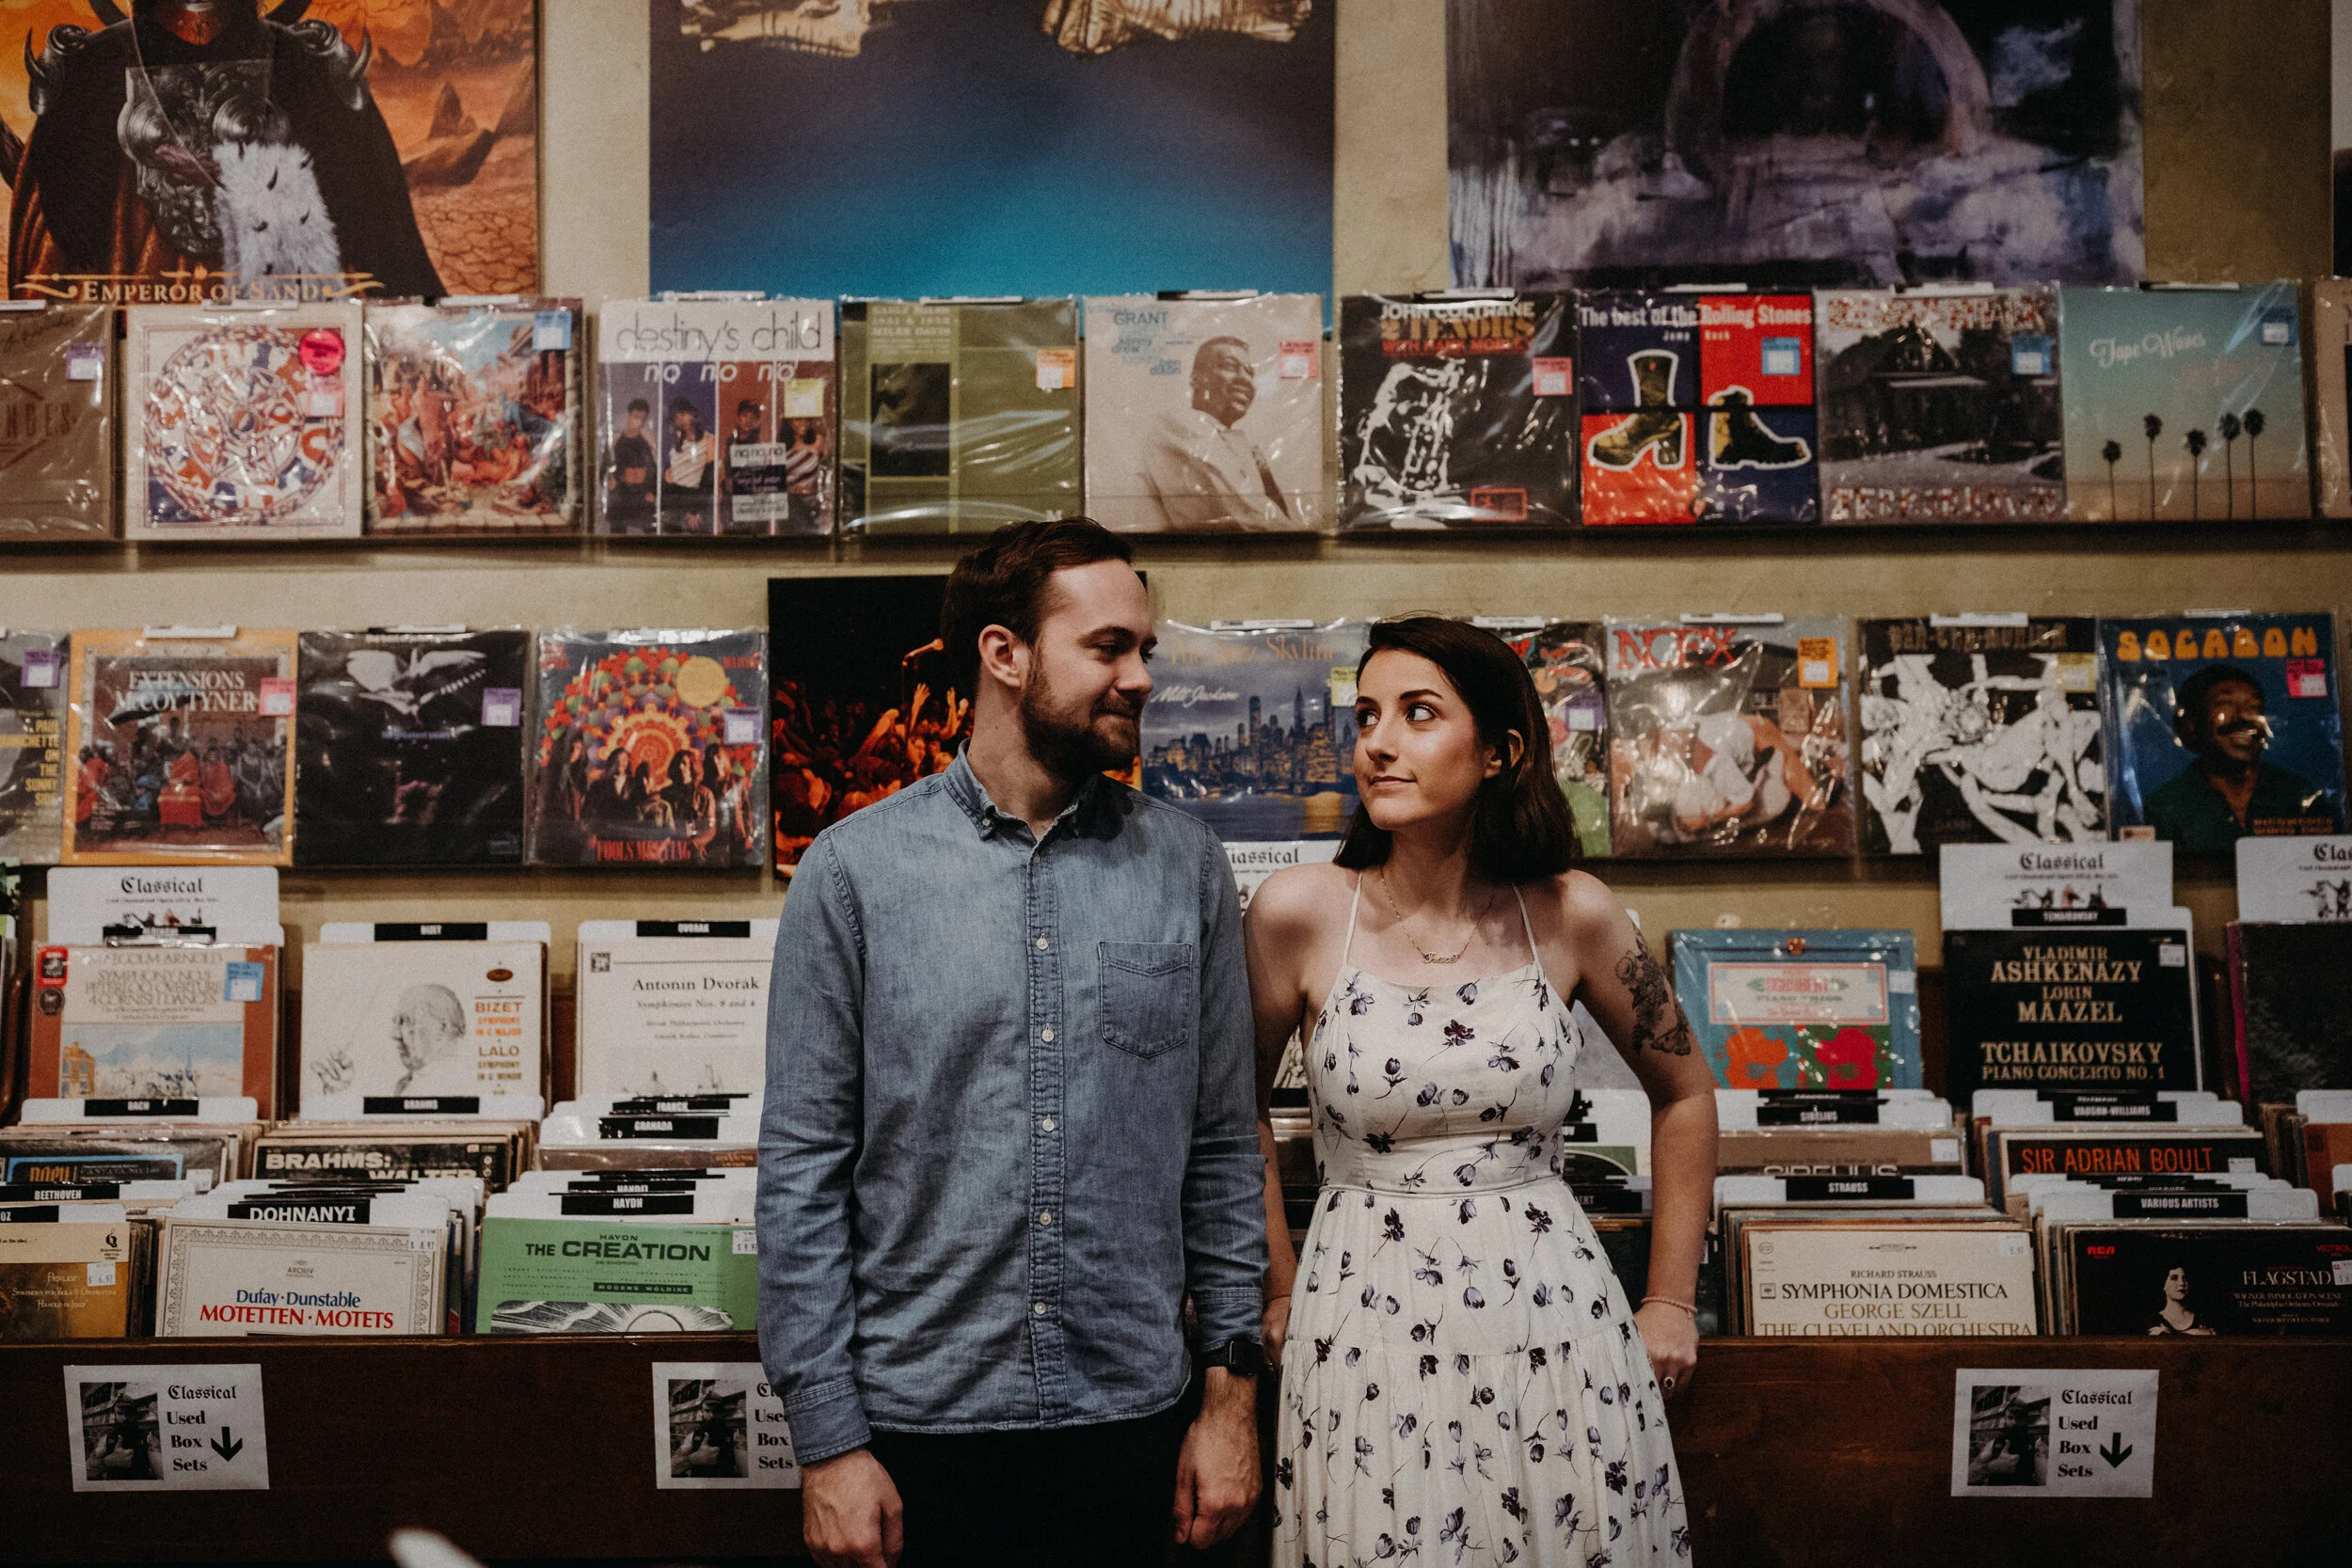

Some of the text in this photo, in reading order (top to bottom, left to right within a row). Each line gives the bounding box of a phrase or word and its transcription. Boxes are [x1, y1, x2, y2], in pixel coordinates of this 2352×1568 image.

[84, 280, 320, 303] EMPEROR OF SAND
[1113, 311, 1168, 326] GRANT
[1380, 301, 1535, 321] JOHN COLTRANE
[1580, 308, 1608, 326] The
[1611, 306, 1647, 326] best
[1651, 304, 1670, 327] of
[1672, 304, 1697, 327] the
[1701, 304, 1756, 329] Rolling
[1756, 304, 1812, 325] Stones
[1380, 315, 1535, 341] 2 TENORS
[616, 310, 822, 362] destiny's child
[645, 361, 797, 384] no no no
[1613, 626, 1738, 670] NOFX
[2116, 626, 2318, 661] SOCABON
[129, 671, 246, 692] EXTENSIONS
[189, 692, 256, 713] TYNER
[2020, 852, 2105, 871] Classical
[120, 875, 204, 895] Classical
[166, 951, 224, 966] ARNOLD
[2022, 946, 2108, 961] VLADIMIR
[1990, 960, 2143, 983] ASHKENAZY
[2042, 986, 2093, 1001] LORIN
[475, 1002, 523, 1013] BIZET
[2017, 1001, 2123, 1023] MAAZEL
[478, 1016, 520, 1025] SYMPHONY
[476, 1028, 485, 1037] IN
[495, 1027, 521, 1037] MAJOR
[478, 1046, 521, 1056] LALO
[1979, 1041, 2165, 1065] TCHAIKOVSKY
[478, 1061, 520, 1069] SYMPHONY
[477, 1071, 485, 1080] IN
[498, 1070, 522, 1080] MINOR
[1981, 1066, 2165, 1081] PIANO CONCERTO NO. 1
[127, 1101, 151, 1112] BACH
[403, 1099, 438, 1110] BRAHMS
[265, 1151, 393, 1170] BRAHMS:
[2021, 1147, 2213, 1173] SIR ADRIAN BOULT
[34, 1189, 83, 1201] BEETHOVEN
[1828, 1181, 1869, 1196] STRAUSS
[612, 1197, 644, 1210] HAYDN
[2140, 1196, 2219, 1211] VARIOUS ARTISTS
[249, 1205, 357, 1223] DOHNANYI
[526, 1241, 711, 1262] THE CREATION
[2086, 1244, 2116, 1256] RCA
[287, 1266, 314, 1275] ARCHIV
[1850, 1270, 1938, 1279] RICHARD STRAUSS
[2242, 1270, 2333, 1287] FLAGSTAD
[236, 1287, 361, 1307] Dufay Dunstable
[1782, 1282, 2009, 1300] SYMPHONIA DOMESTICA
[199, 1305, 393, 1329] MOTETTEN MOTETS
[1824, 1303, 1968, 1319] GEORGE SZELL
[1759, 1323, 2033, 1337] THE CLEVELAND ORCHESTRA
[168, 1385, 237, 1400] Classical
[2061, 1388, 2133, 1405] Classical
[167, 1411, 206, 1425] Used
[2058, 1415, 2098, 1430] Used
[171, 1433, 203, 1449] Box
[756, 1433, 789, 1446] Box
[2059, 1440, 2091, 1454] Box
[173, 1457, 208, 1472] Sets
[758, 1456, 793, 1469] Sets
[2058, 1464, 2093, 1478] Sets
